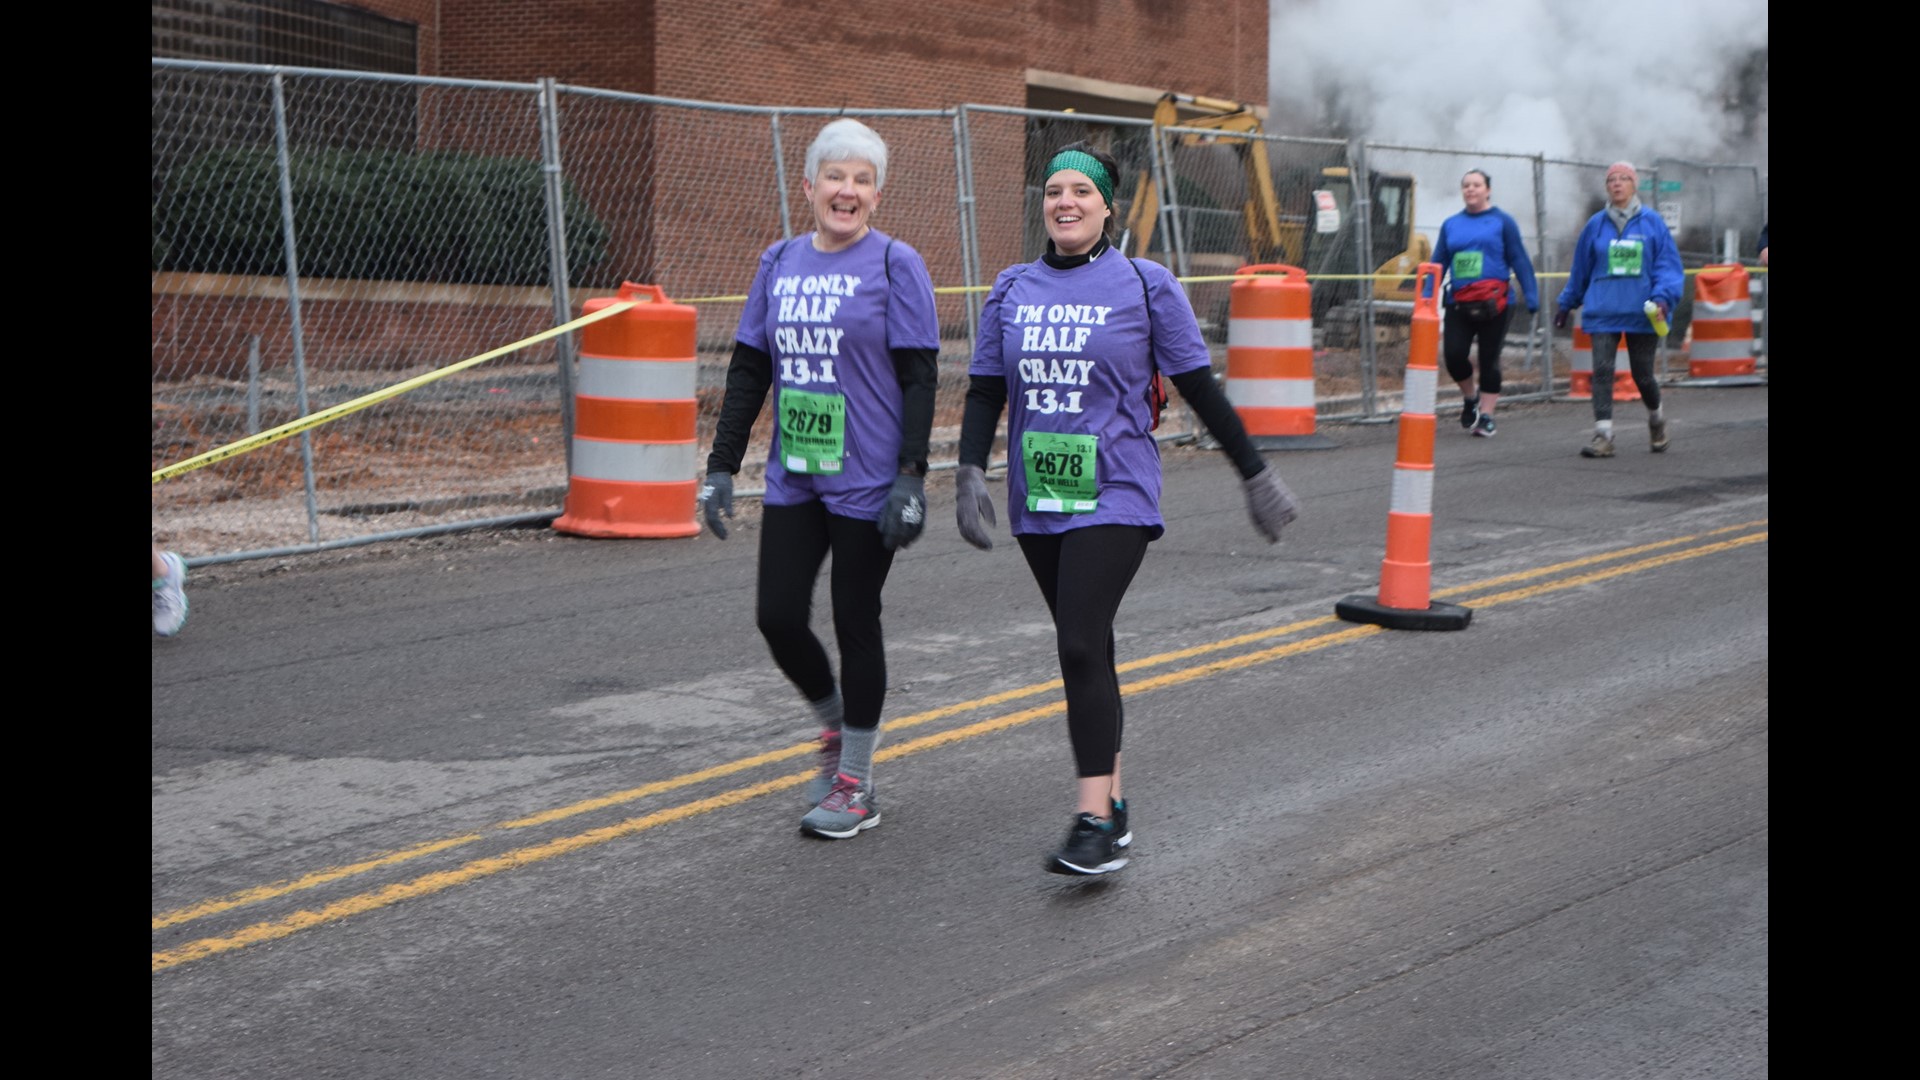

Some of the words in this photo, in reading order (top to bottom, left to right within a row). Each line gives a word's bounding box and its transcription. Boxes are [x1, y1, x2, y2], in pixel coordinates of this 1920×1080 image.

[773, 275, 801, 296] I'M
[802, 274, 862, 297] ONLY
[778, 295, 841, 323] HALF
[1013, 305, 1046, 324] I'M
[1047, 304, 1113, 326] ONLY
[775, 326, 845, 356] CRAZY
[1021, 326, 1091, 352] HALF
[780, 357, 837, 385] 13.1
[1018, 358, 1096, 386] CRAZY
[1024, 388, 1084, 414] 13.1
[786, 408, 832, 435] 2679
[1076, 444, 1092, 454] 13.1
[1033, 450, 1083, 478] 2678
